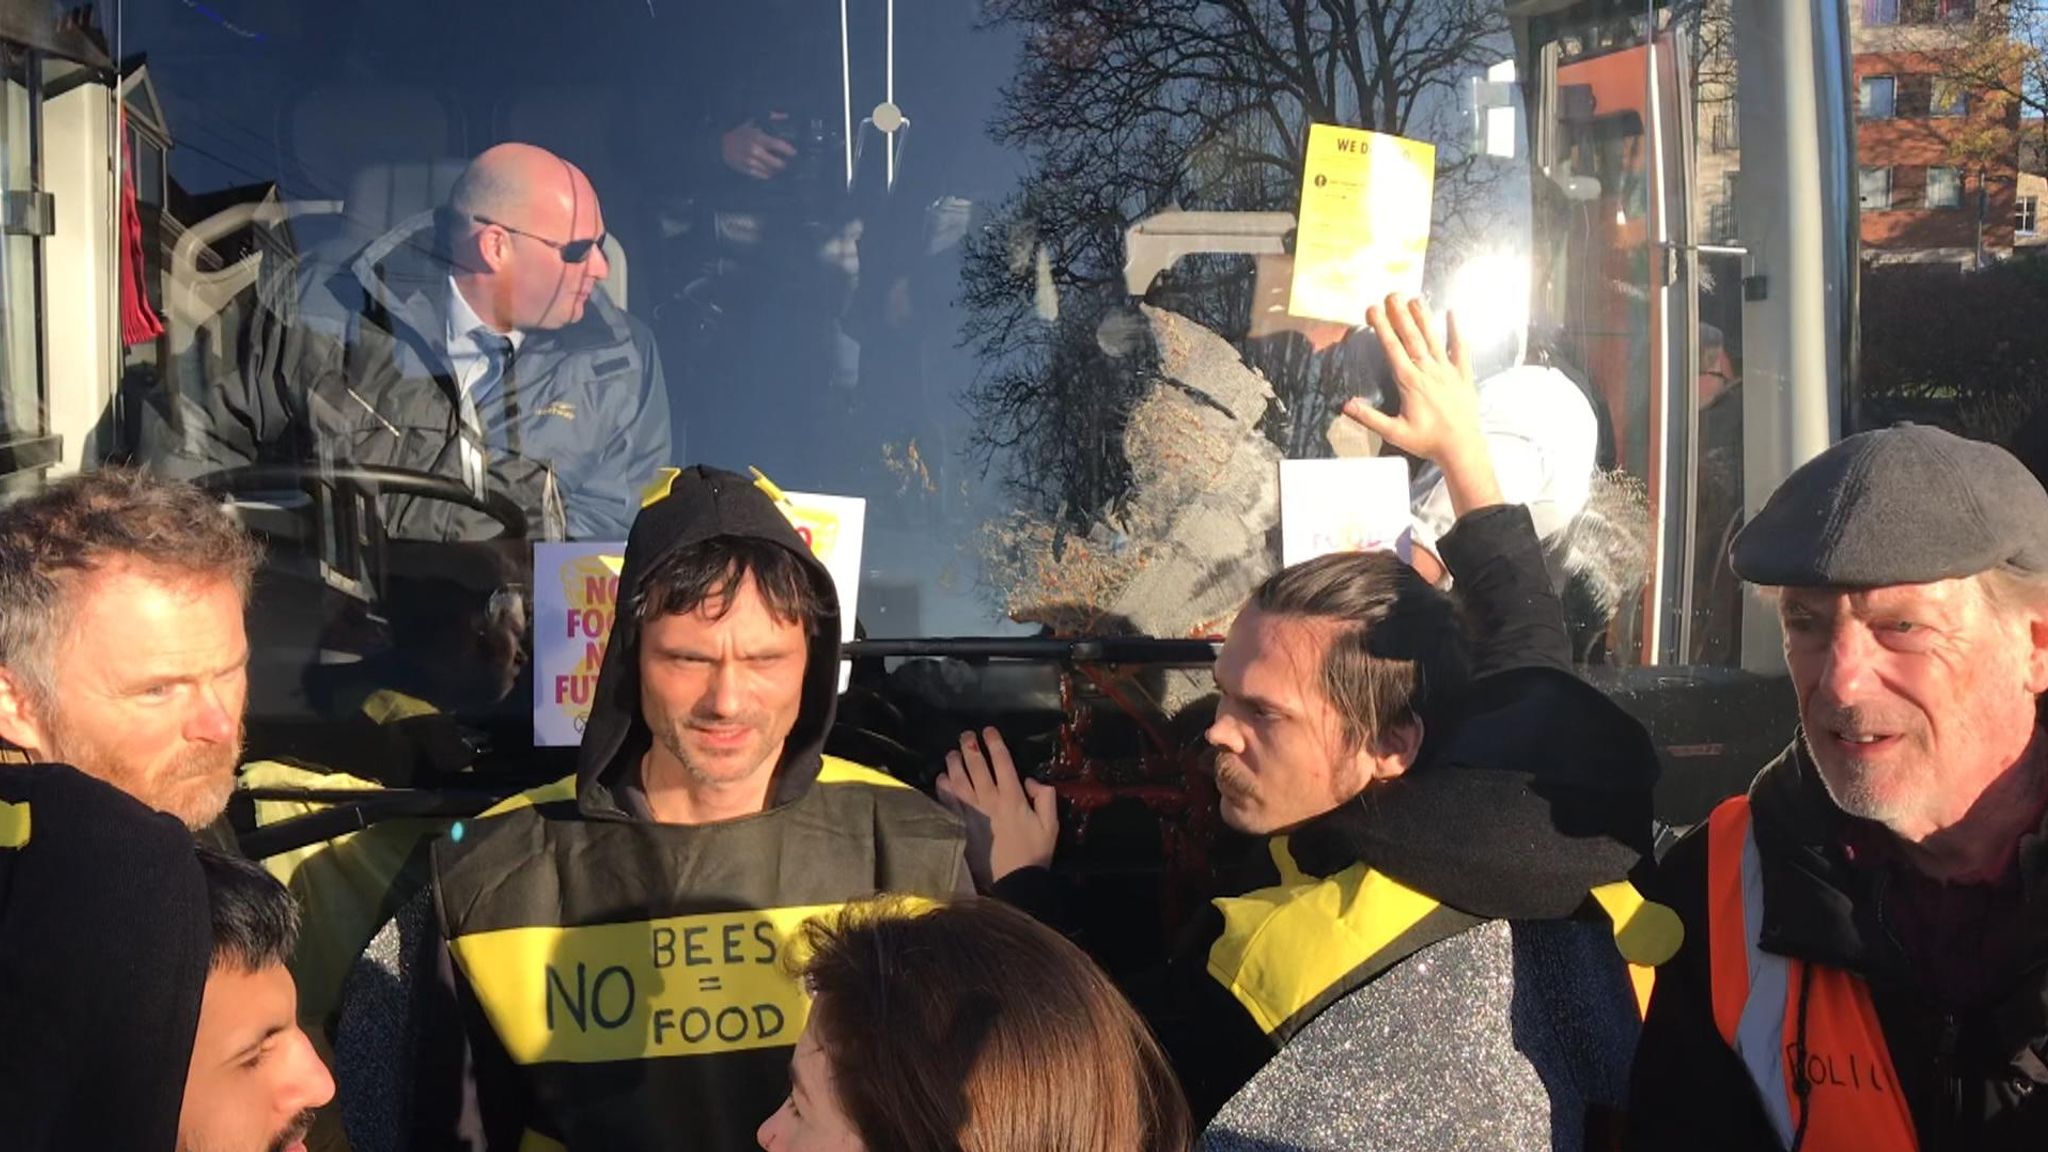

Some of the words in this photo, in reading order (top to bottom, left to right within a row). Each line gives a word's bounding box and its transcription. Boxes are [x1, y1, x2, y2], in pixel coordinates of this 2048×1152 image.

[1337, 138, 1356, 153] WE
[653, 921, 776, 968] BEES
[545, 962, 634, 1032] NO
[653, 1004, 785, 1045] FOOD
